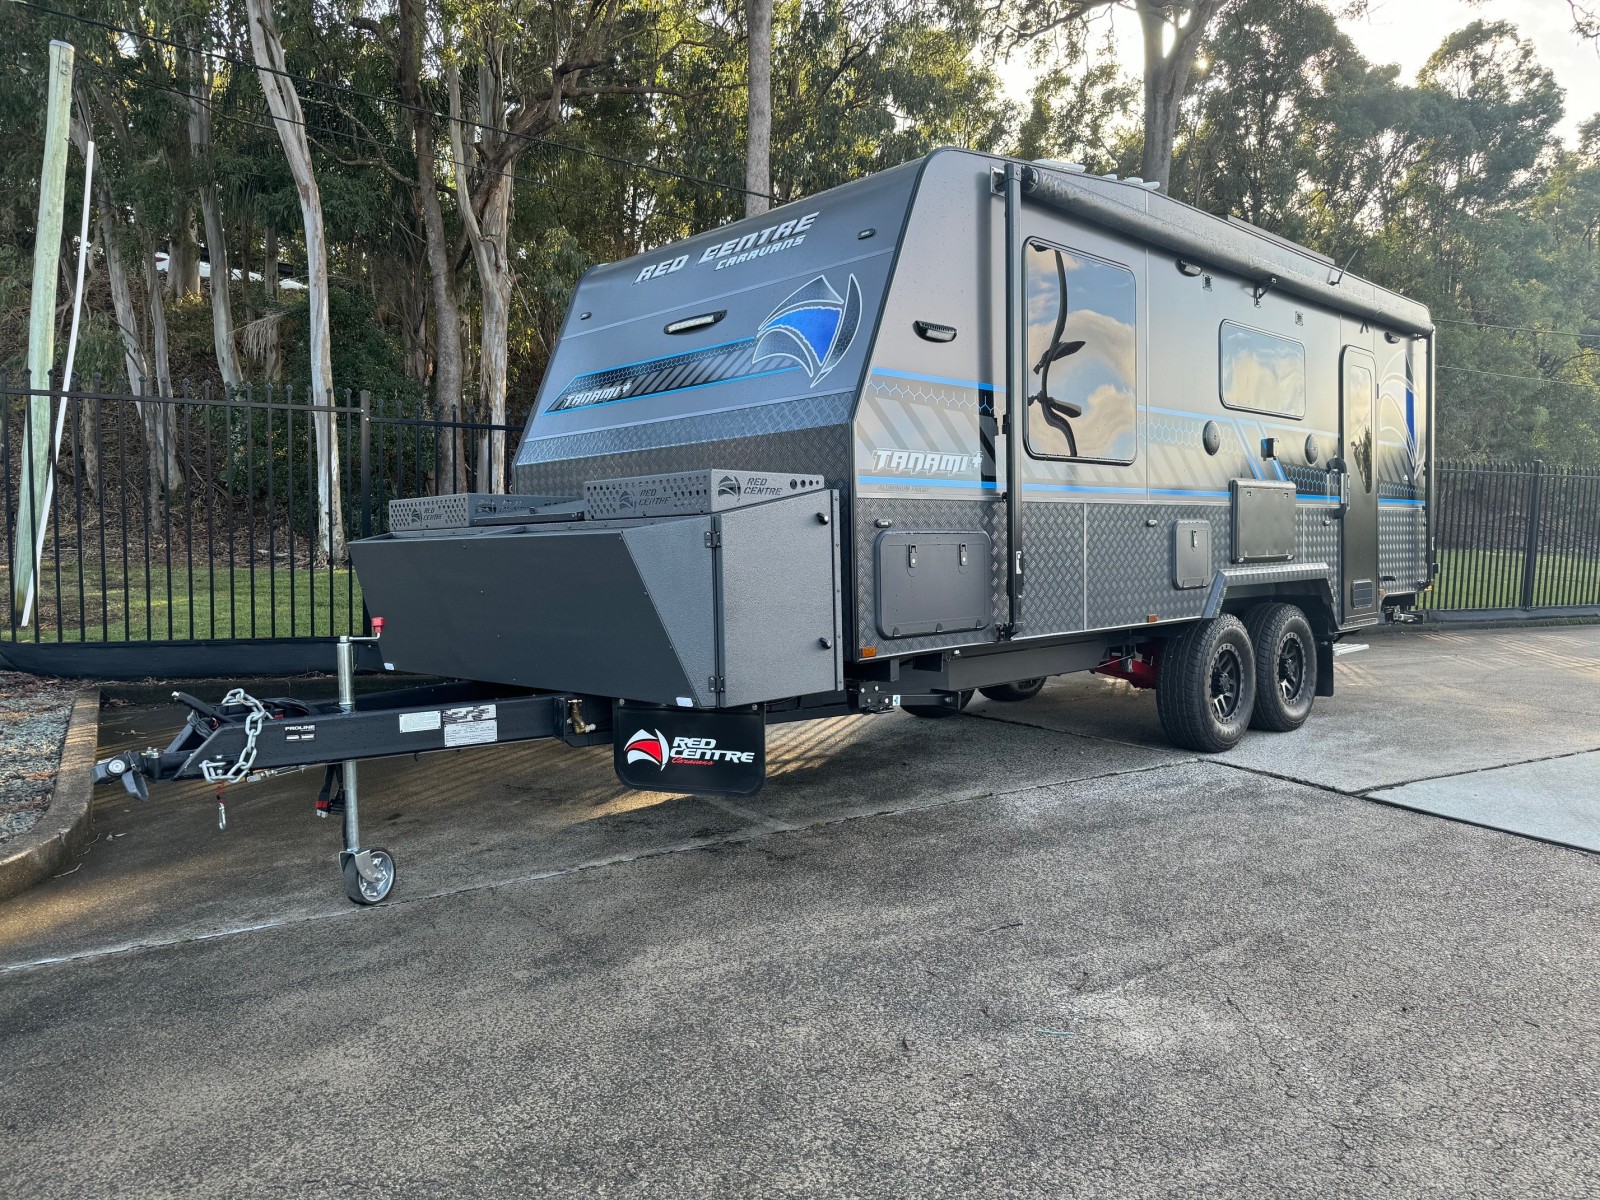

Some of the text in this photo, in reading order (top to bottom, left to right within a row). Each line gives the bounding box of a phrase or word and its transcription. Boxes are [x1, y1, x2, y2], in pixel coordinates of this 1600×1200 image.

[631, 210, 821, 286] RED CENTRE
[713, 234, 807, 272] CARAVANS
[746, 477, 768, 486] RED
[640, 488, 657, 497] RED
[743, 486, 783, 496] CENTRE
[638, 496, 672, 506] CENTRE
[422, 513, 444, 521] CENTRE
[672, 736, 717, 749] RED
[669, 747, 756, 764] CENTRE
